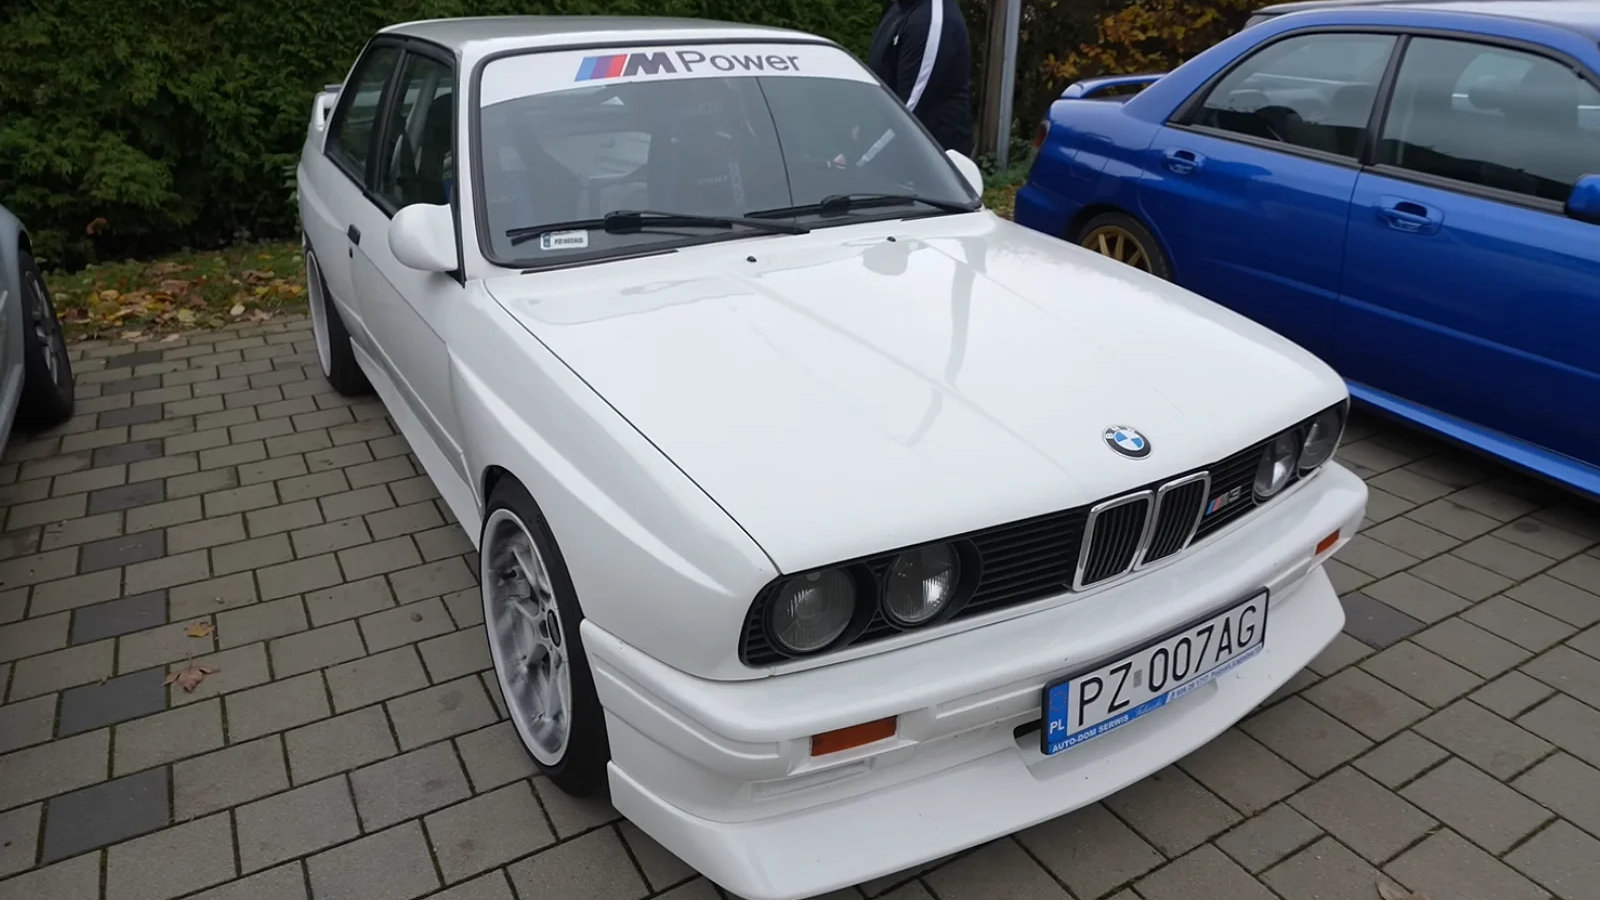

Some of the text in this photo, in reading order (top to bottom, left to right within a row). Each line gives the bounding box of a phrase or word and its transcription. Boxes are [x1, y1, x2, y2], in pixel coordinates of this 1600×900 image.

[1077, 661, 1133, 727] PZ
[1148, 605, 1257, 693] 007AG
[1049, 718, 1065, 735] PL
[1052, 714, 1129, 753] AUTO-DOM SERWIS
